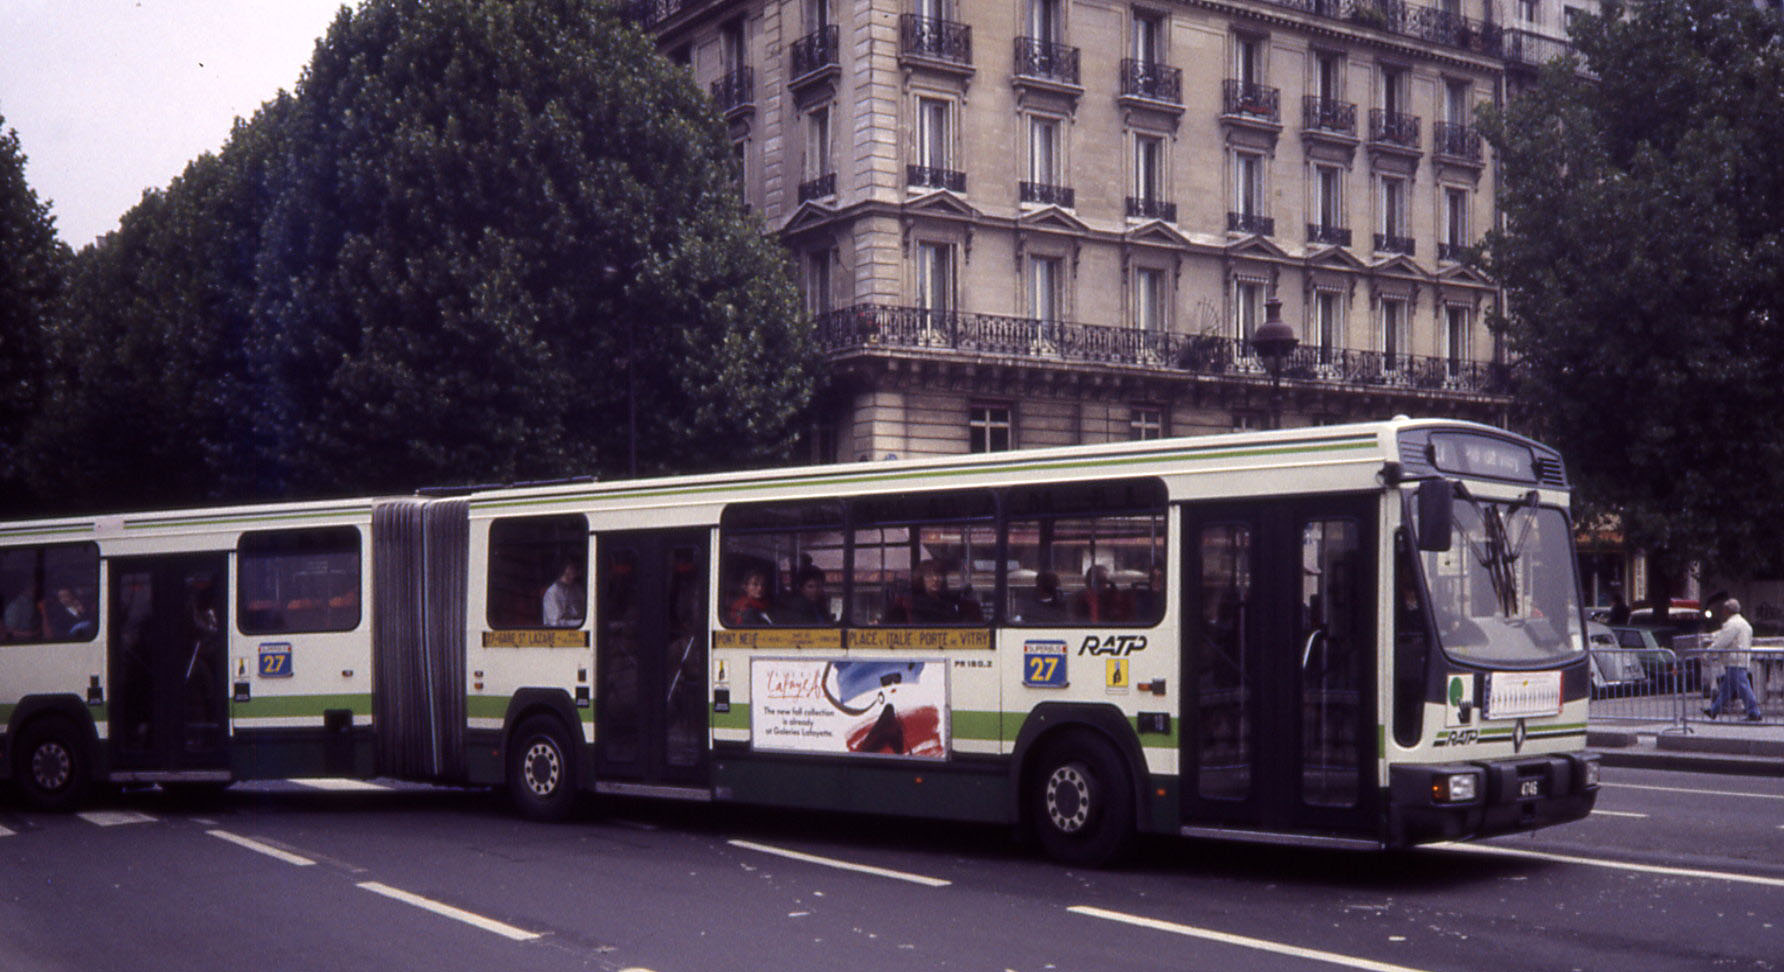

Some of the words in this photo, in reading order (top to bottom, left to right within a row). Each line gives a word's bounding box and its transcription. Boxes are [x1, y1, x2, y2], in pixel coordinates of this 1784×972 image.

[849, 631, 878, 646] PLACE
[919, 631, 948, 646] PORTE
[959, 631, 988, 646] VITRY
[1078, 635, 1148, 656] RATP
[263, 655, 286, 673] 27
[954, 660, 966, 668] PR
[1029, 656, 1059, 681] 27
[764, 706, 775, 715] The
[792, 706, 803, 715] fall
[804, 706, 835, 717] collection
[765, 727, 773, 735] at
[773, 725, 801, 736] Galeries
[782, 717, 788, 725] is
[789, 717, 814, 729] already
[1446, 729, 1479, 747] RATP
